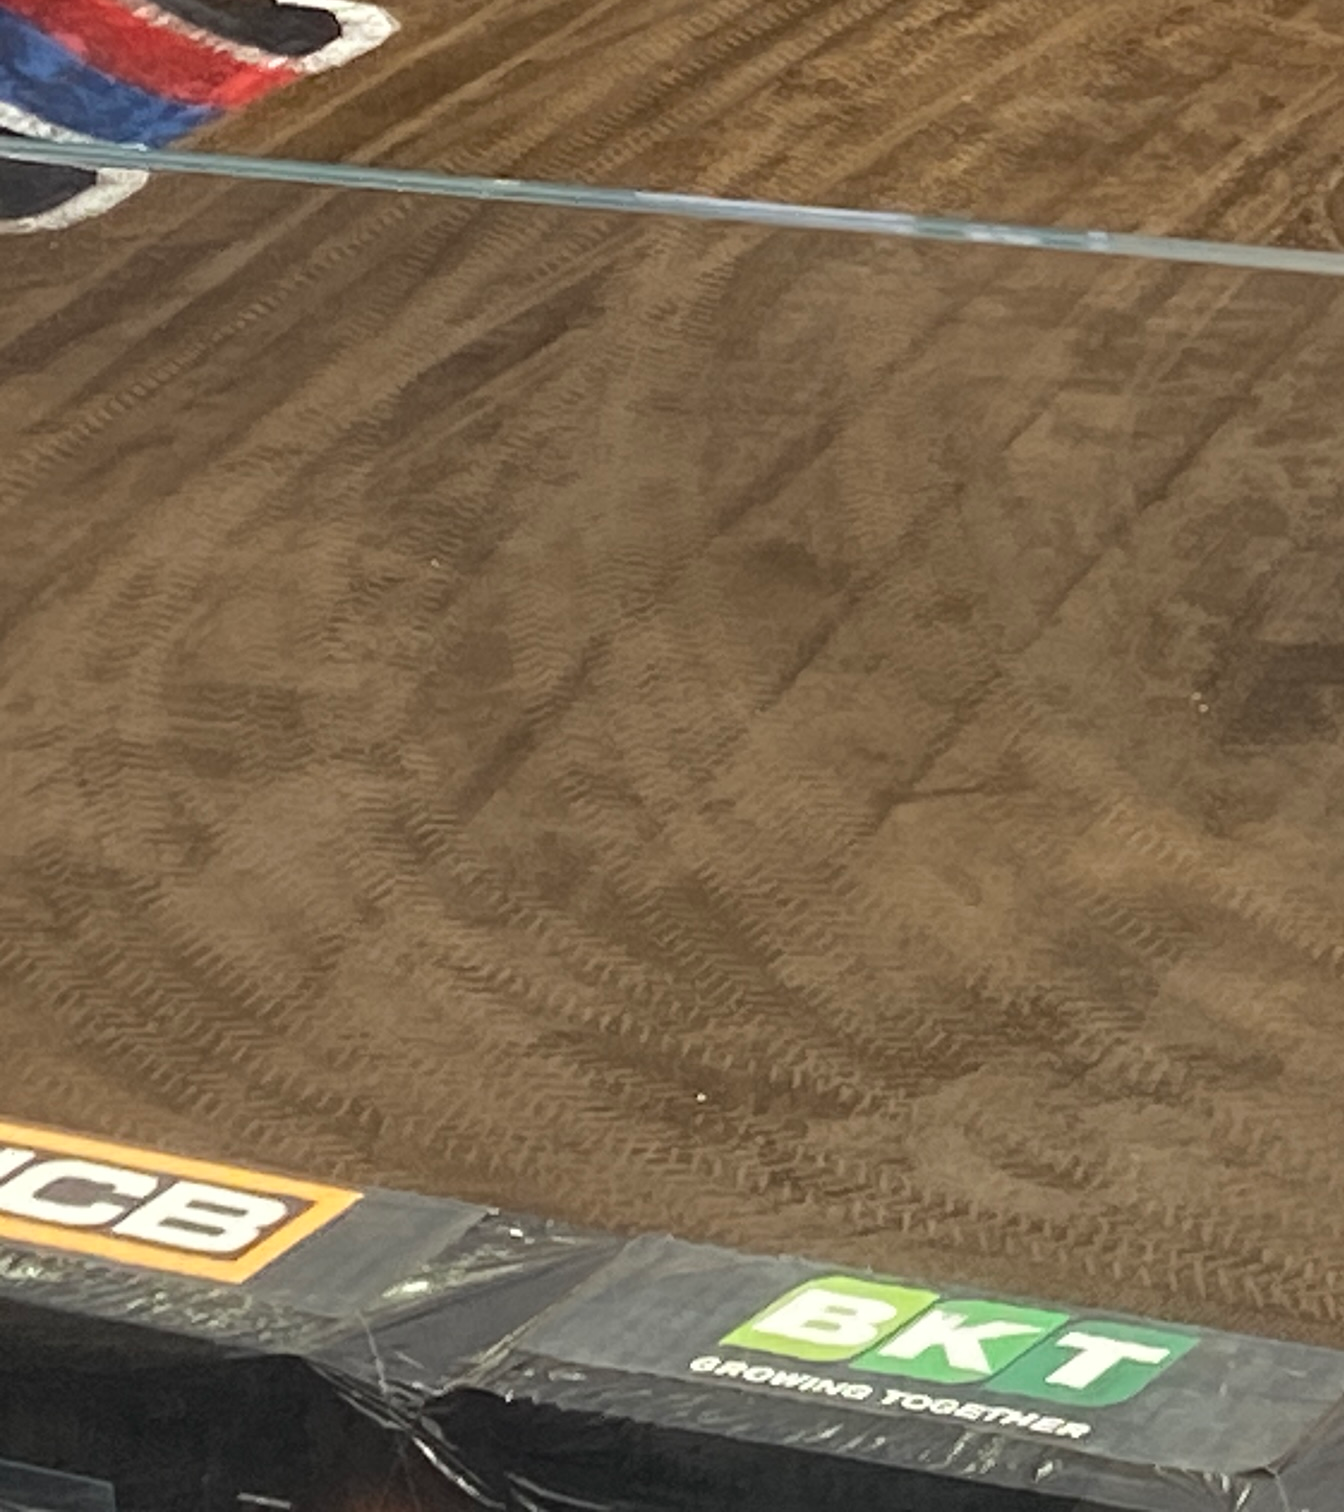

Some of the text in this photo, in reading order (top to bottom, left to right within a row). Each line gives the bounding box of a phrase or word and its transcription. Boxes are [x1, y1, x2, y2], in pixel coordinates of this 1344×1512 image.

[751, 1287, 1171, 1390] BKT
[688, 1354, 1092, 1439] GROWING TOGETHER
